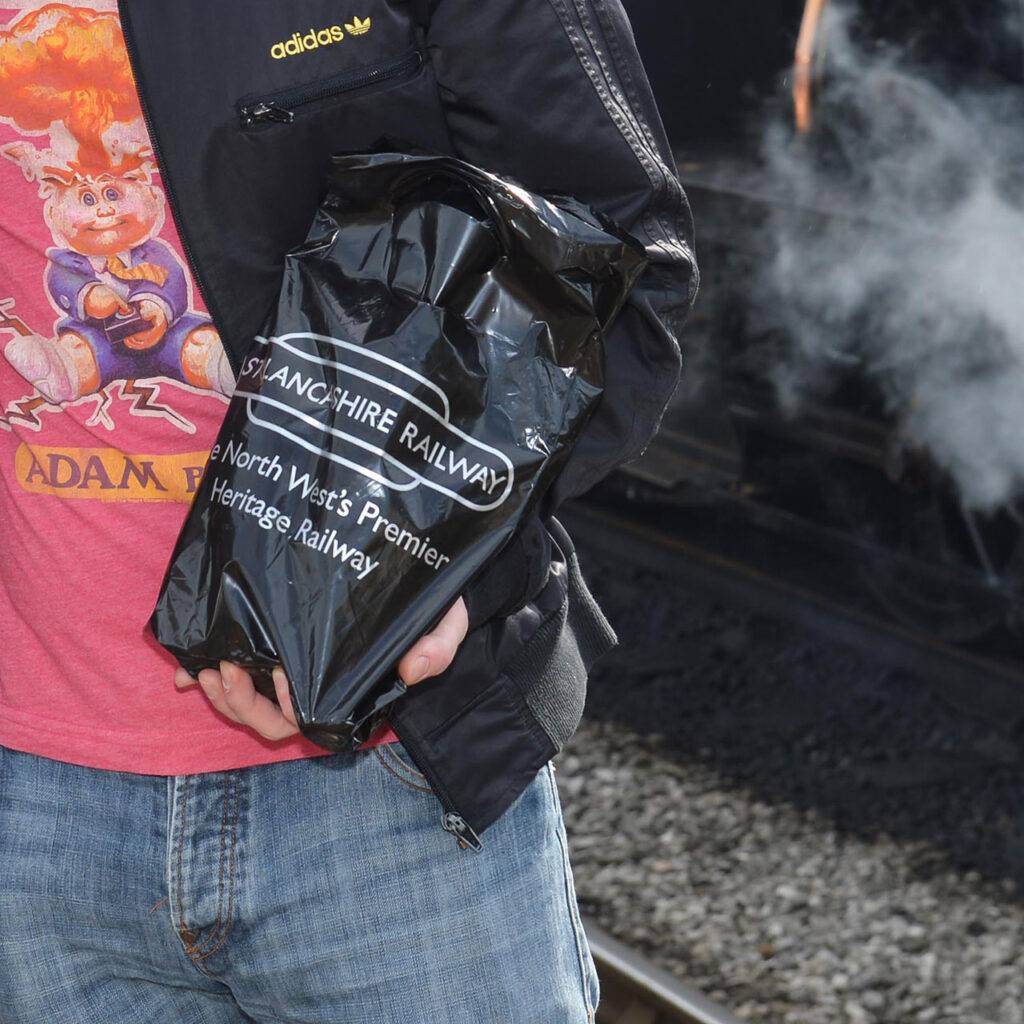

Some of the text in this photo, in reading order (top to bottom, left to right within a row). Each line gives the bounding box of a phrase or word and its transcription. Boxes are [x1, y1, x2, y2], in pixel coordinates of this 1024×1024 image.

[270, 25, 344, 59] adidas
[25, 451, 168, 492] ADAM
[262, 357, 399, 434] LANCASHIRE
[399, 422, 507, 495] RAILWAY
[210, 478, 380, 580] Heritage Railway
[222, 439, 284, 482] North
[287, 466, 351, 517] West's
[356, 504, 450, 571] Premier
